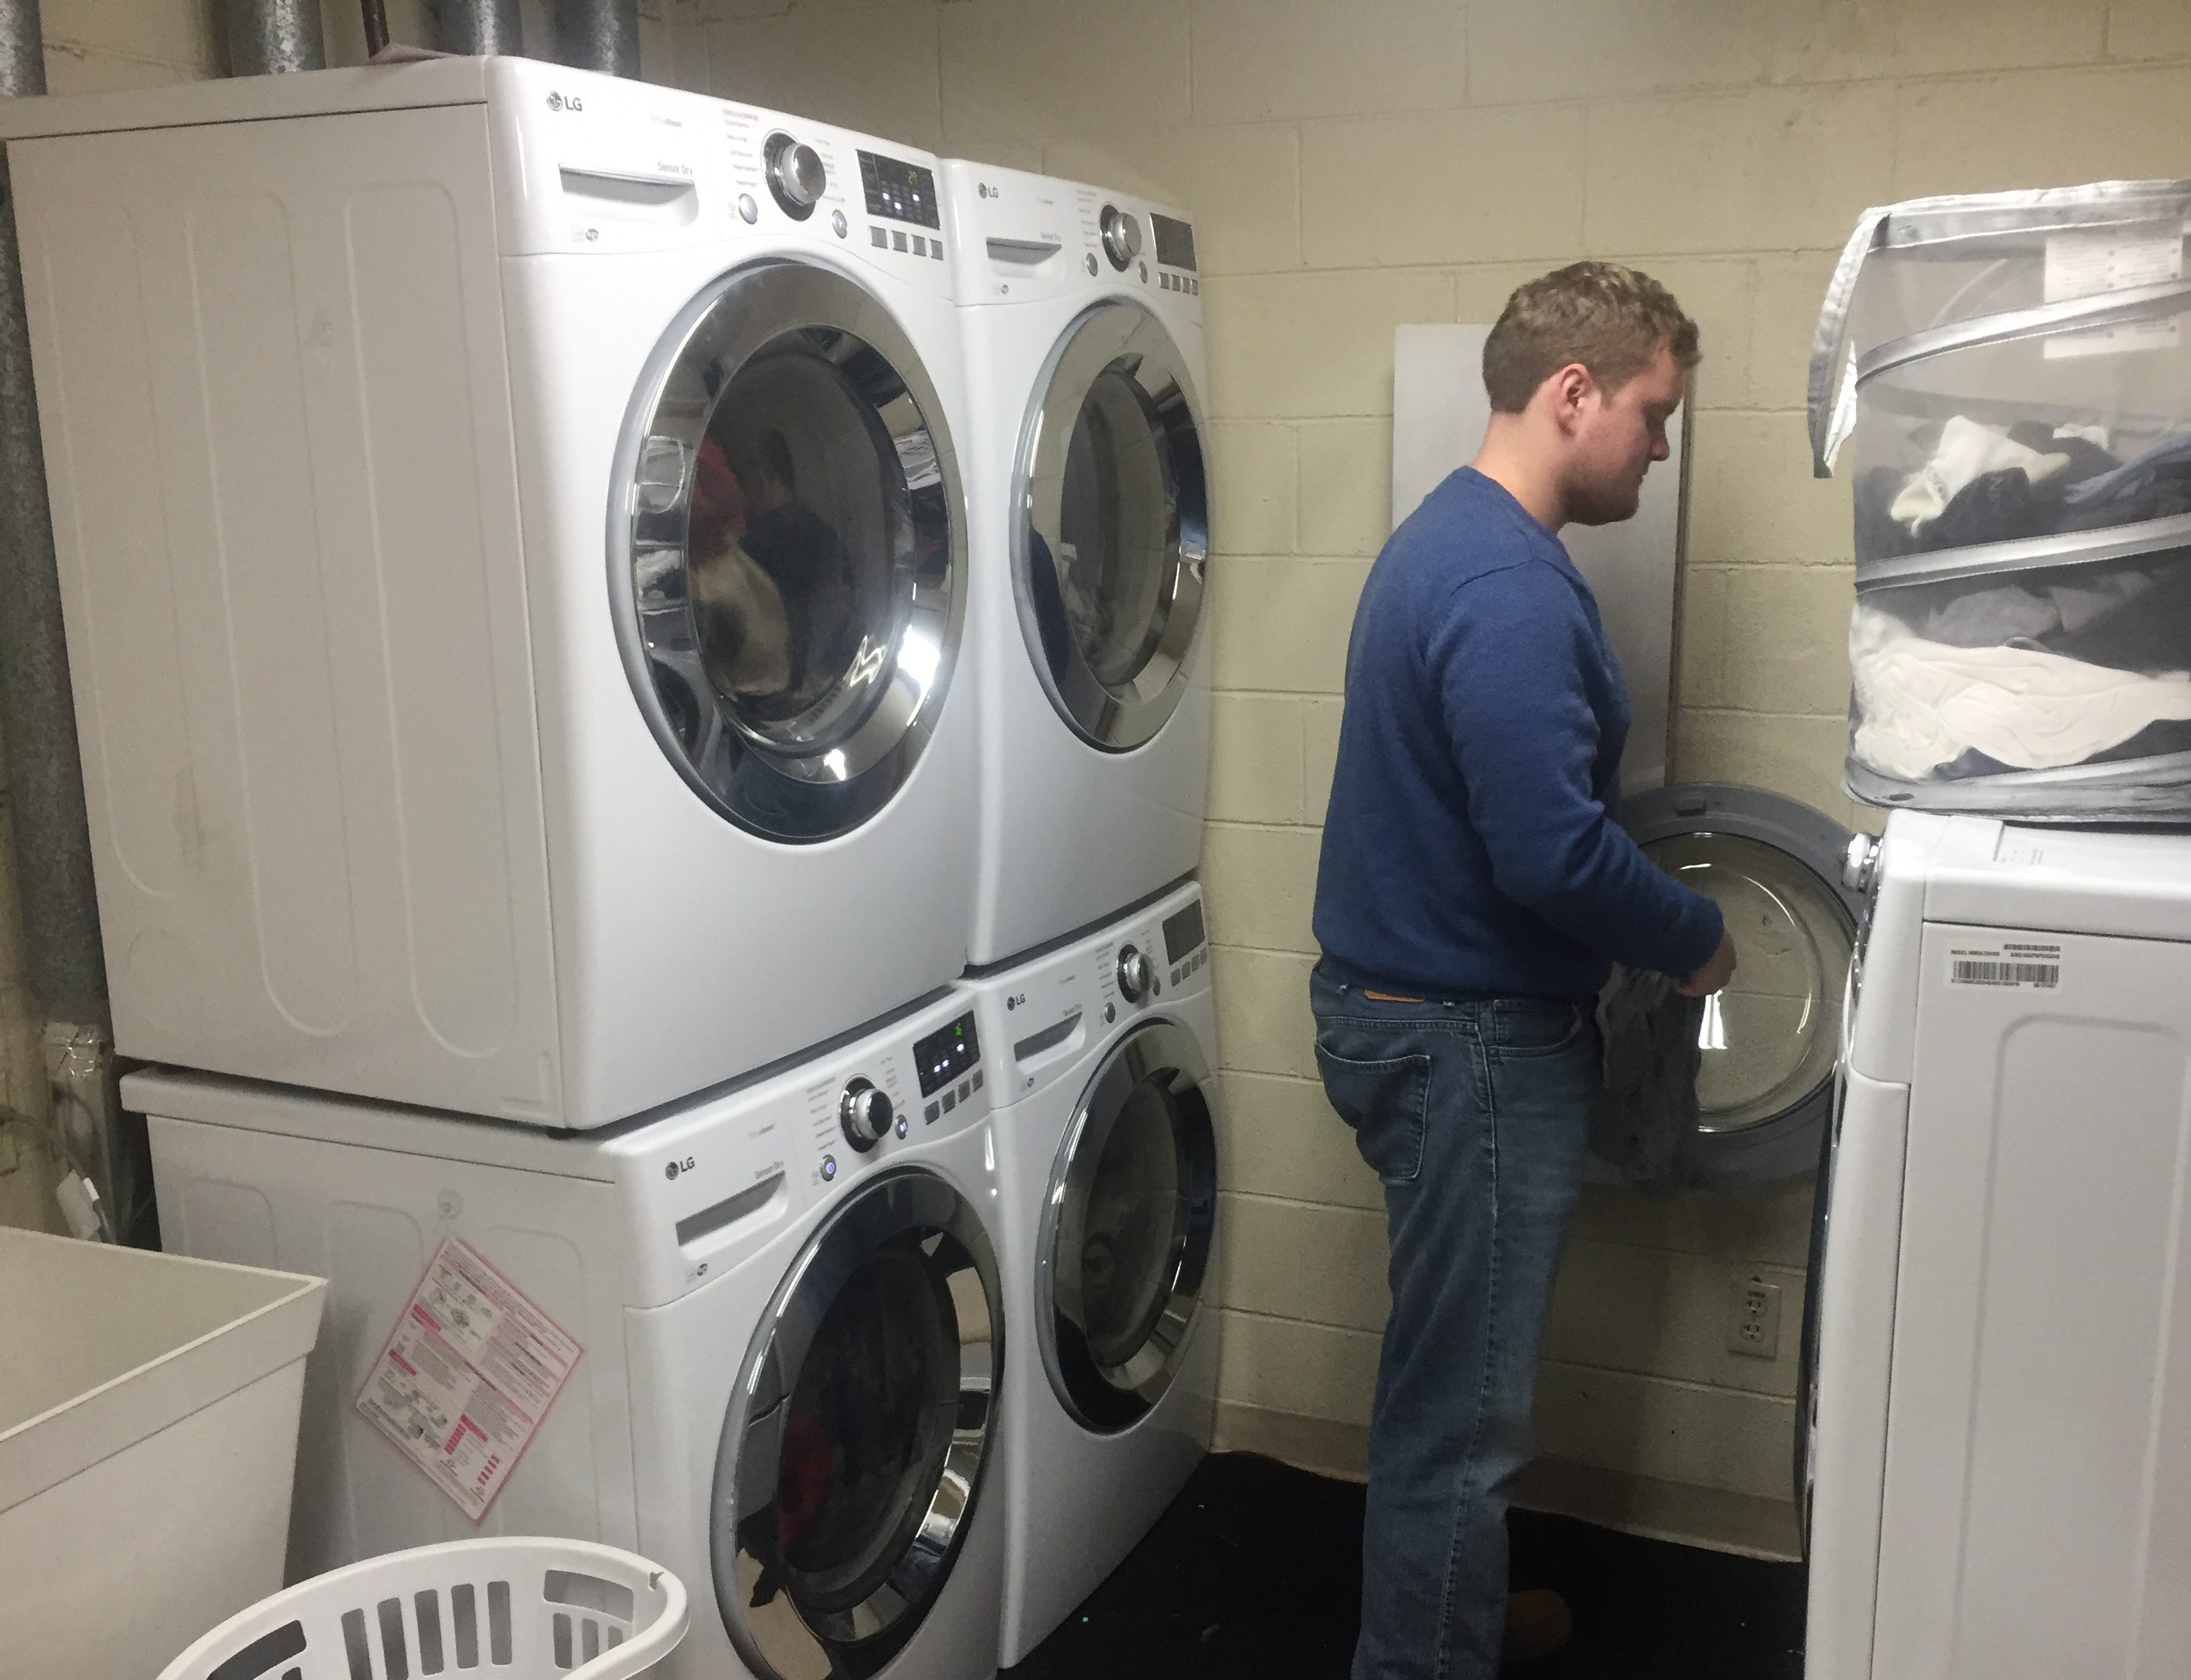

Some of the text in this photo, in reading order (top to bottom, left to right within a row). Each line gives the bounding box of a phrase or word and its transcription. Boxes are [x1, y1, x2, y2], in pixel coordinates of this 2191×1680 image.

[564, 96, 582, 112] LG
[657, 161, 693, 177] Sensor Dry
[988, 186, 999, 198] LG
[1016, 994, 1026, 1006] LG
[679, 1156, 696, 1173] LG
